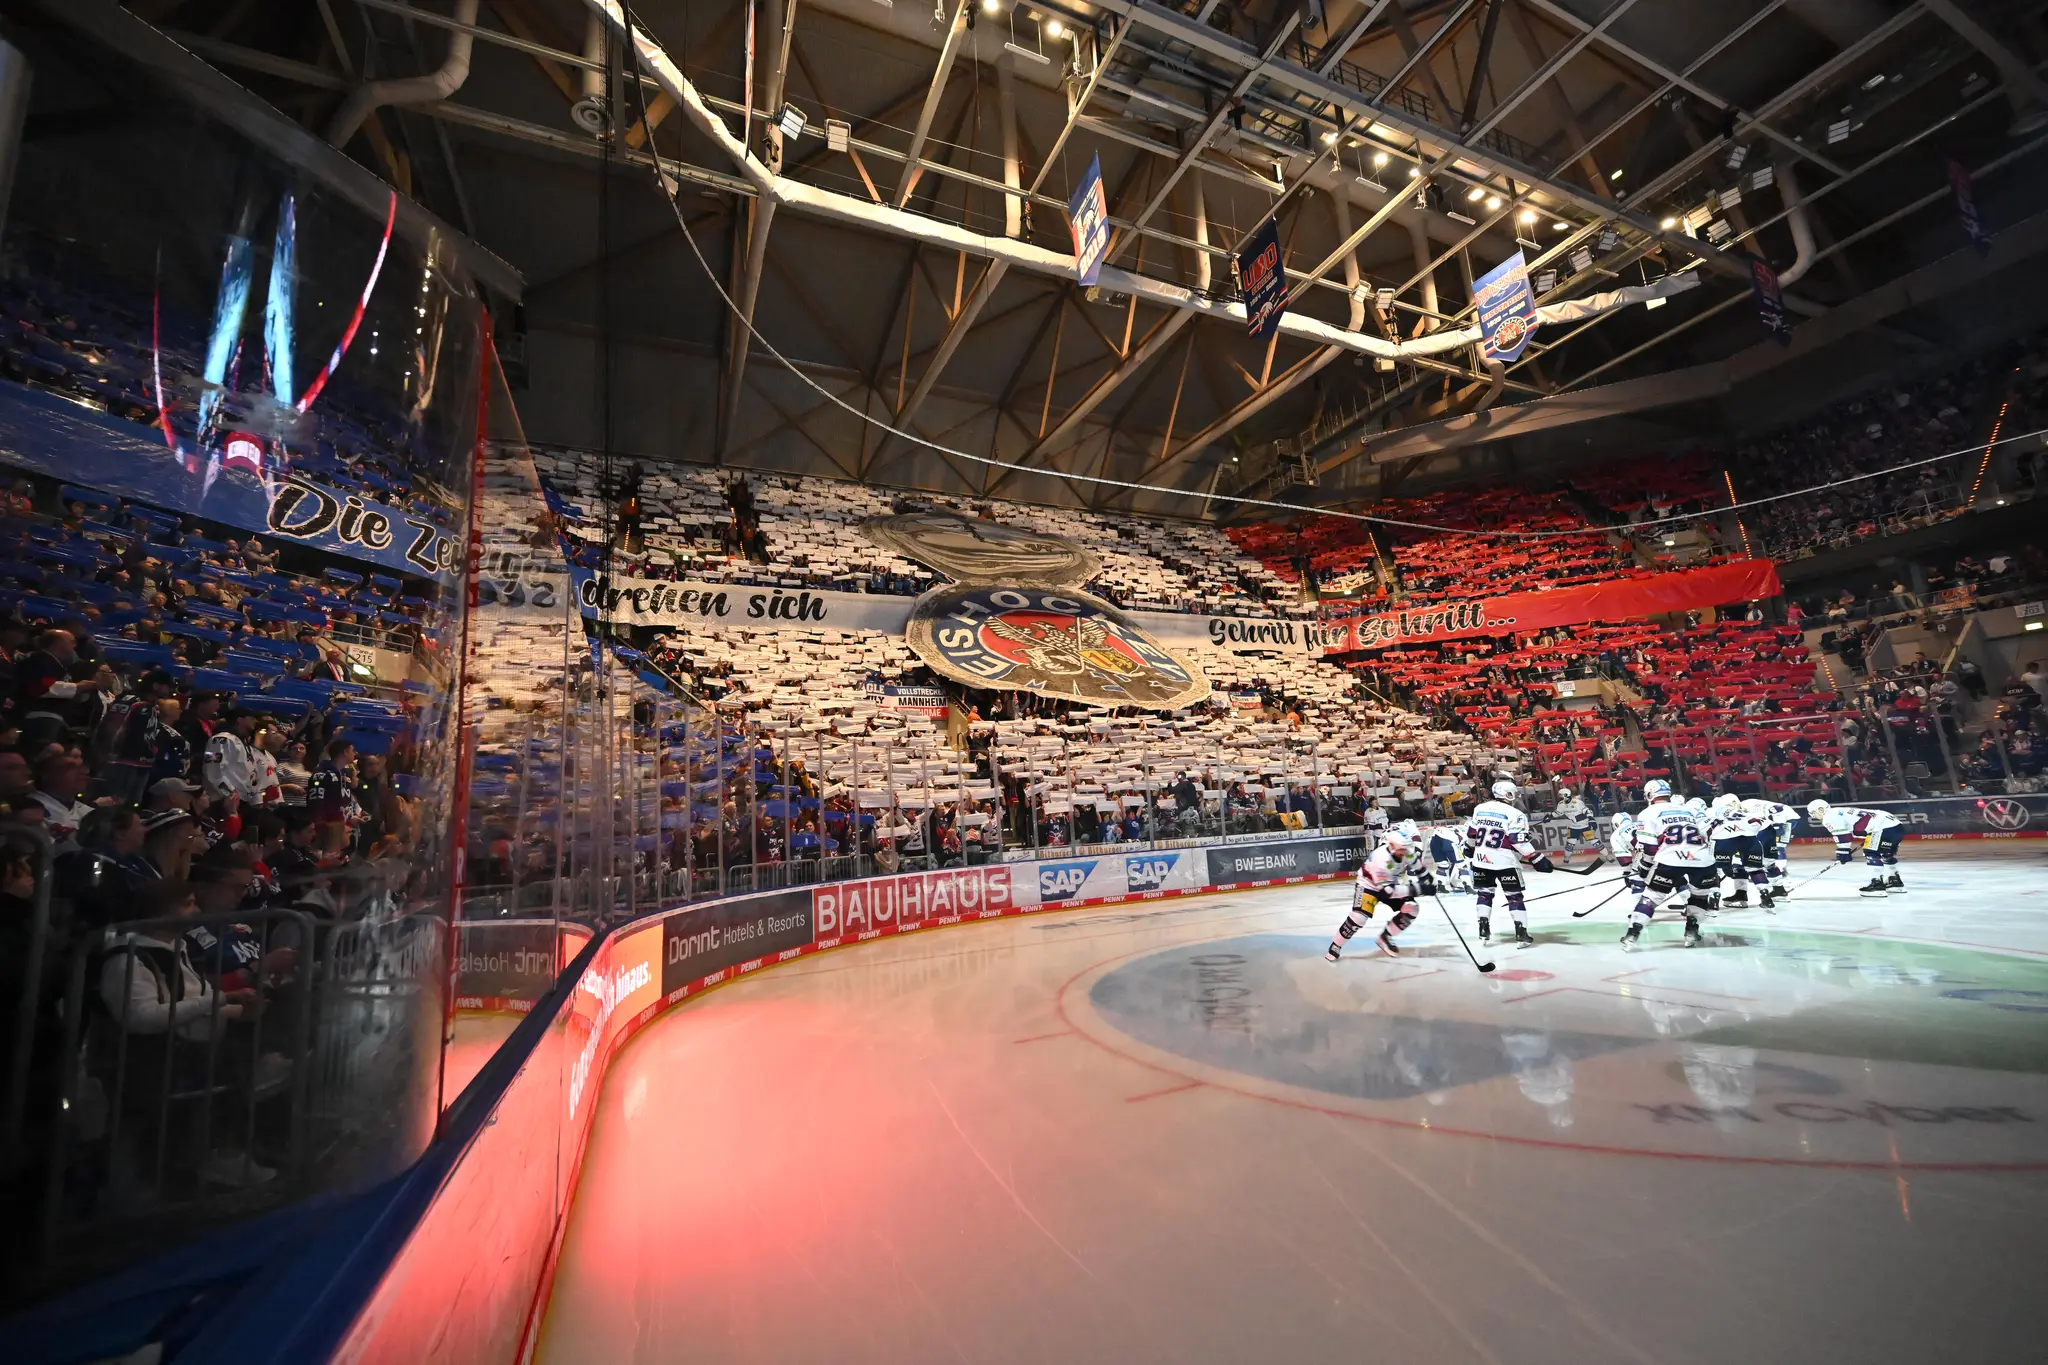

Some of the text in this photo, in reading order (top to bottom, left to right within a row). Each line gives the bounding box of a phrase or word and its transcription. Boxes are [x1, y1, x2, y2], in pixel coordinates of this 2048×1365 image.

[267, 480, 392, 550] Die
[747, 589, 828, 621] sich
[1209, 618, 1348, 651] Schritt für
[356, 653, 373, 664] 215
[898, 696, 948, 707] MANNHEIM
[1475, 827, 1506, 849] 93
[1664, 825, 1702, 845] 92
[1041, 868, 1085, 895] SAP
[1127, 861, 1168, 885] SAP
[1654, 875, 1673, 884] JOKA
[818, 872, 1009, 932] BAUHAUS
[669, 912, 805, 965] Dorint Hotels & Resorts
